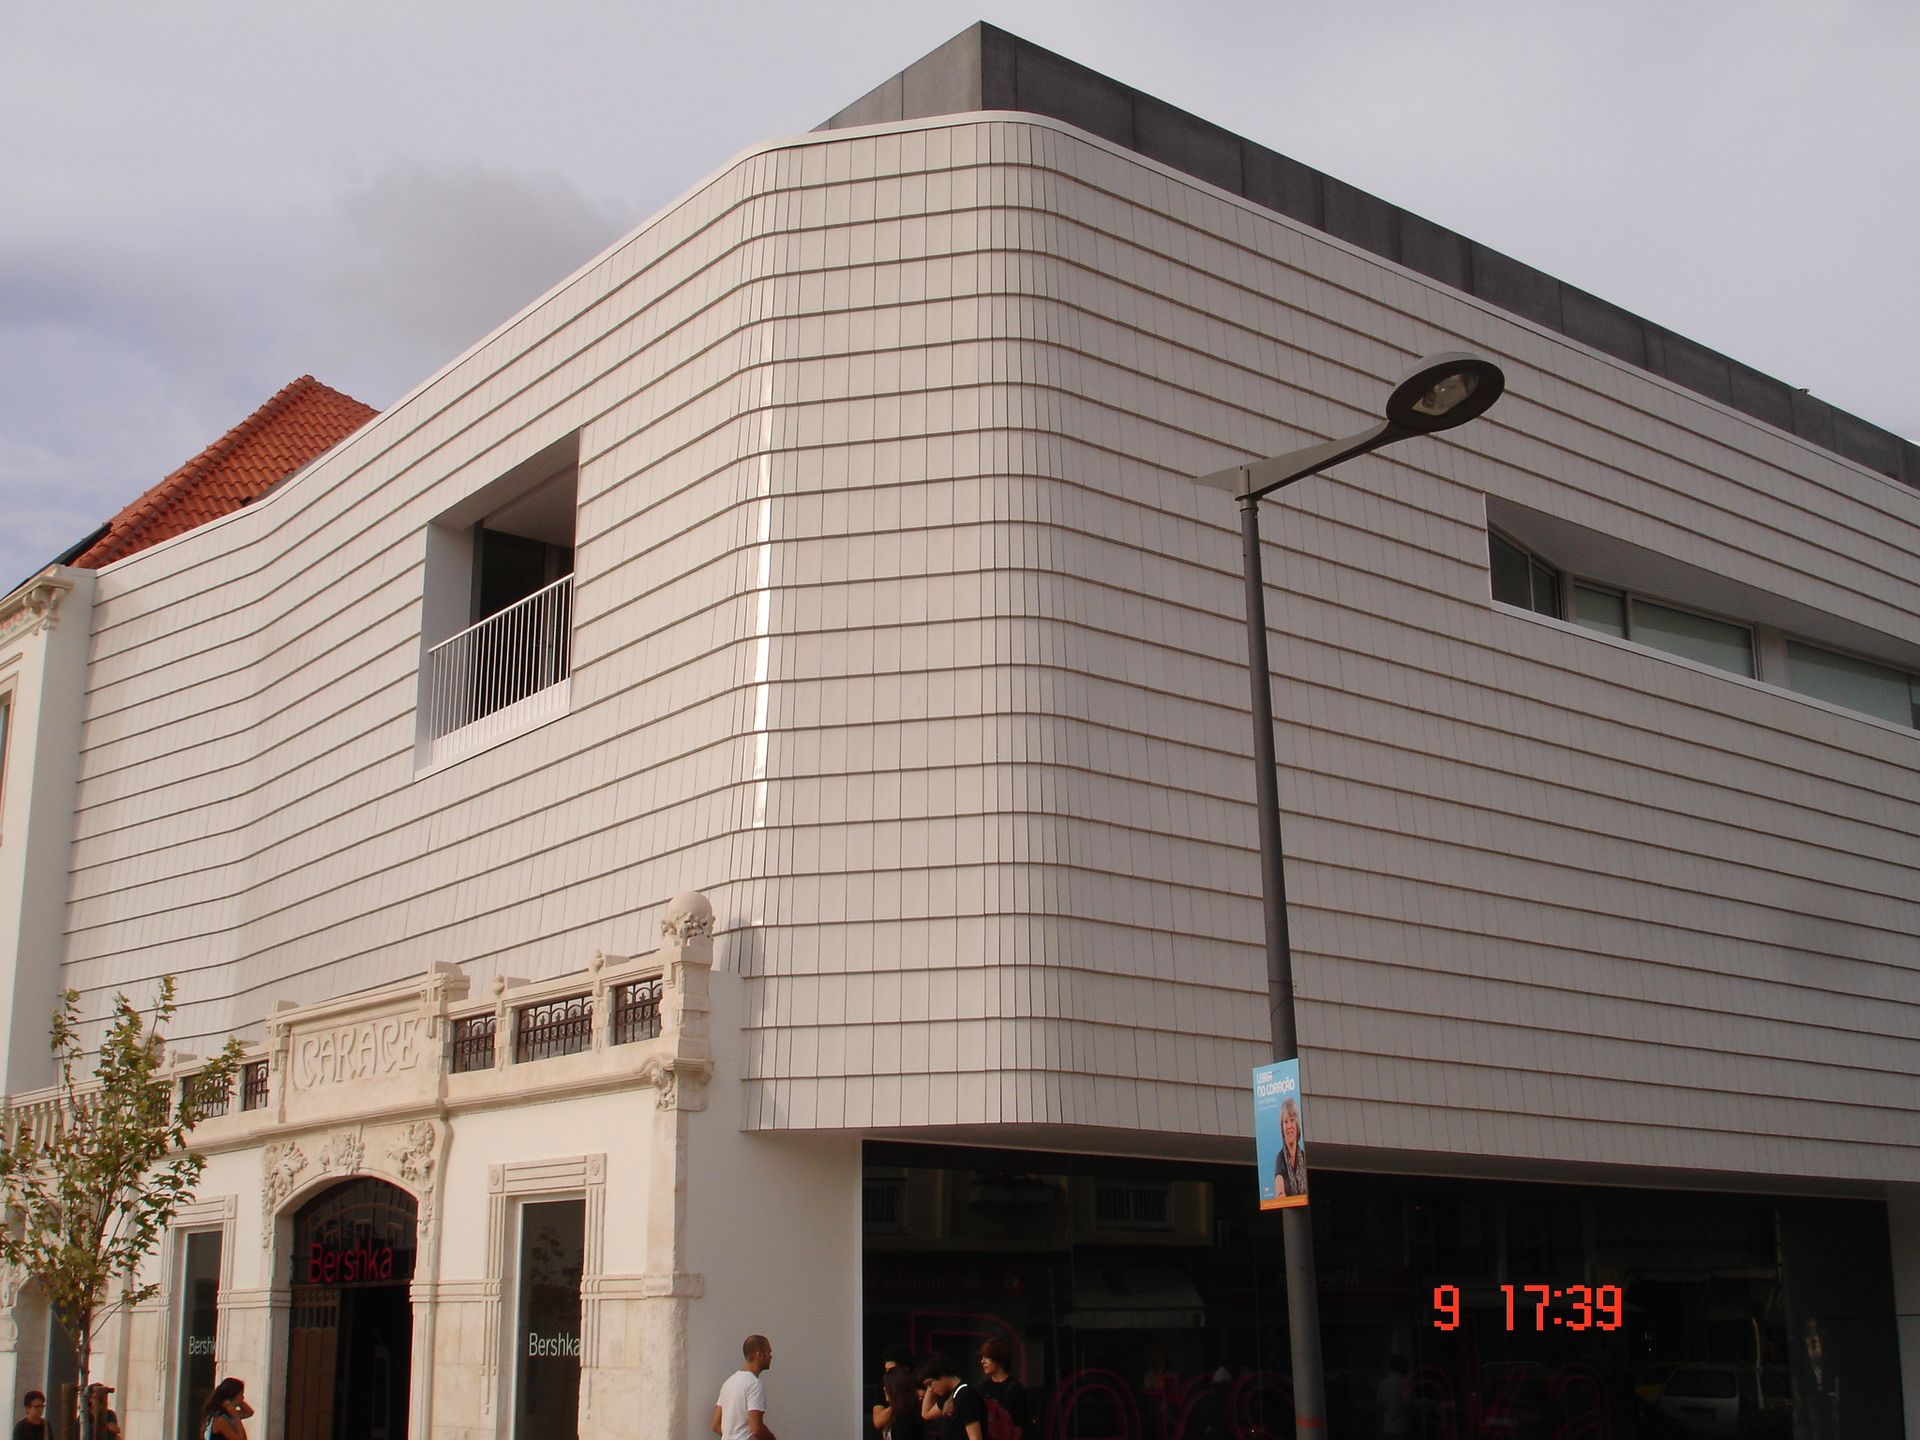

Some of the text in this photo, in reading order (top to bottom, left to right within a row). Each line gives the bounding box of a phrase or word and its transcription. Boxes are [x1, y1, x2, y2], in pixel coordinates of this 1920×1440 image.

[308, 1239, 393, 1283] Bershka
[189, 1335, 217, 1355] Bershk
[528, 1332, 581, 1357] Bershka
